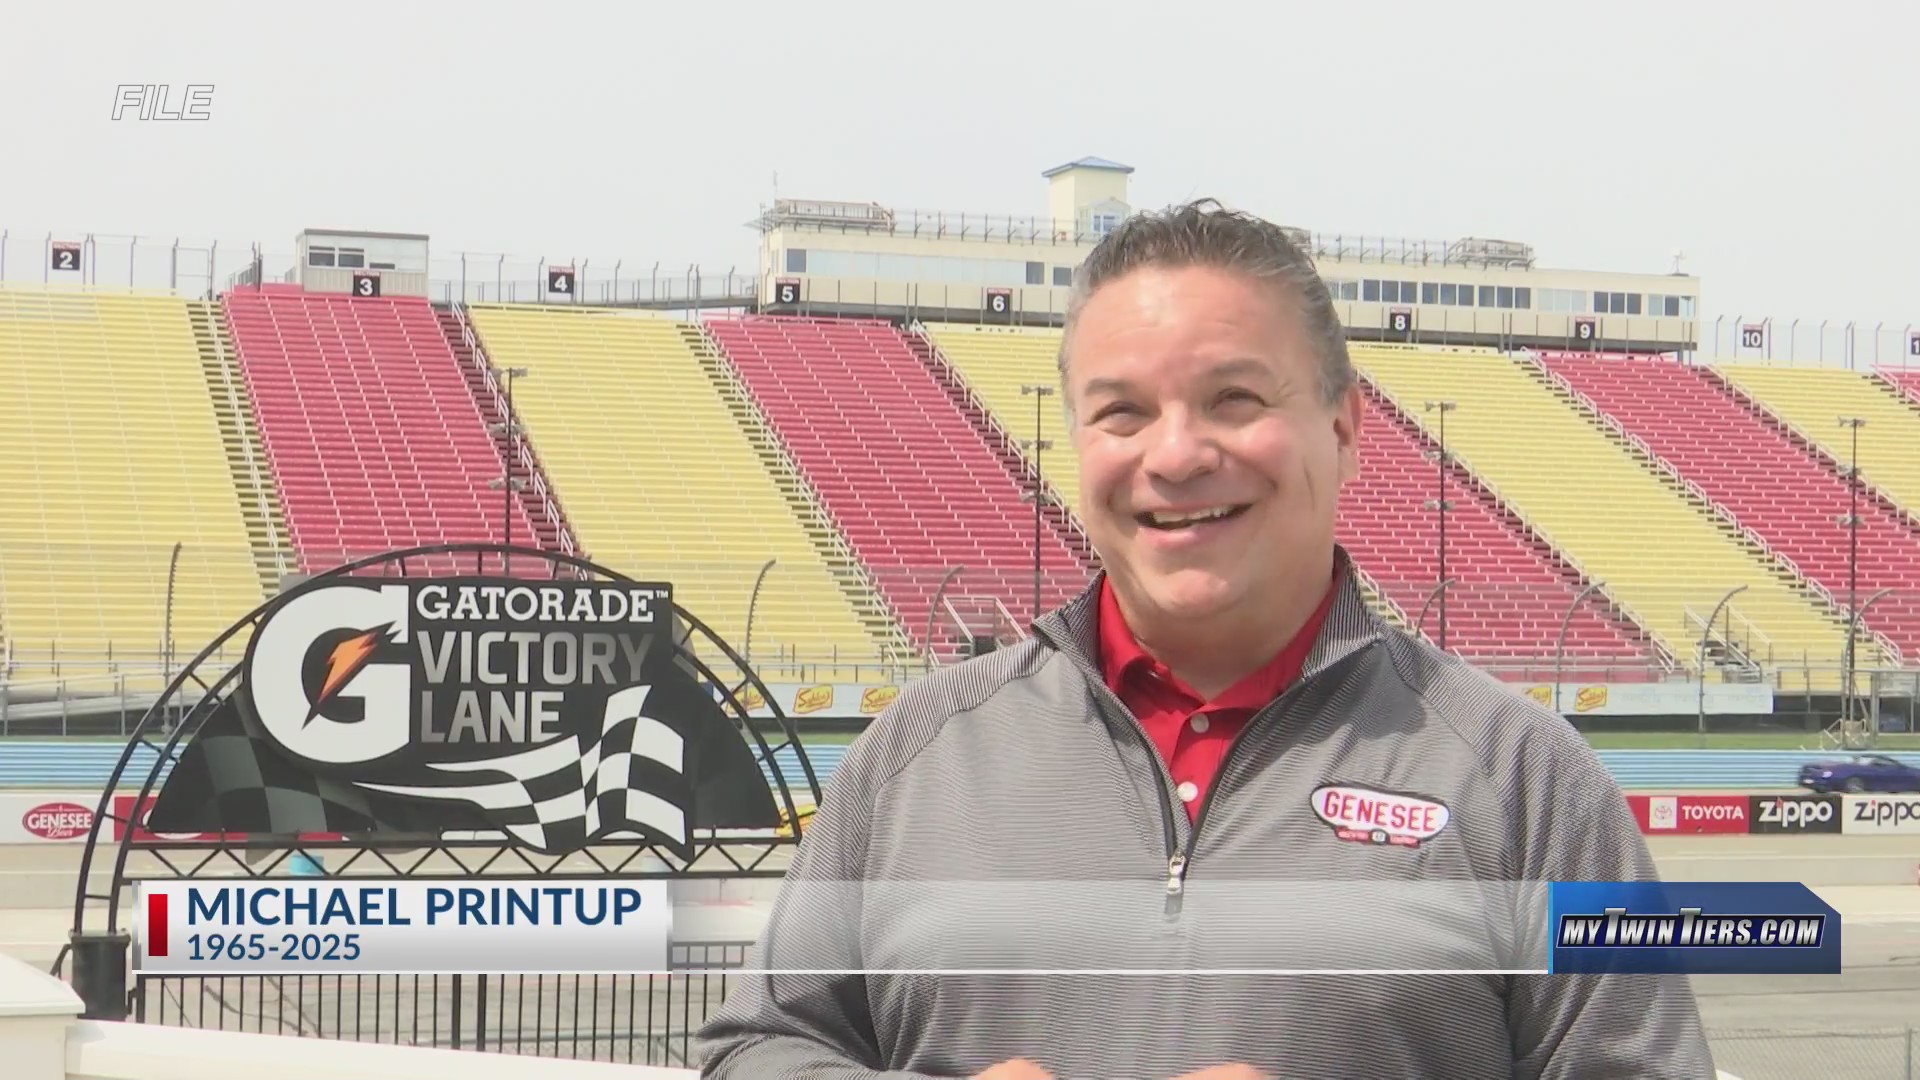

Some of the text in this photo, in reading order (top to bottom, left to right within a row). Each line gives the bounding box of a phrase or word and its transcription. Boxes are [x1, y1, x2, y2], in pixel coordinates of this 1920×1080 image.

[59, 251, 73, 269] 2
[359, 278, 373, 296] 3
[554, 275, 568, 292] 4
[781, 286, 794, 303] 5
[992, 295, 1005, 312] 6
[1394, 315, 1406, 331] 8
[1579, 323, 1591, 340] 9
[1744, 332, 1762, 347] 10
[416, 630, 655, 685] VICTORY
[421, 690, 565, 743] LANE
[1323, 791, 1438, 832] GENESEE
[1682, 805, 1744, 820] TOYOTA
[27, 812, 92, 829] GENESEE
